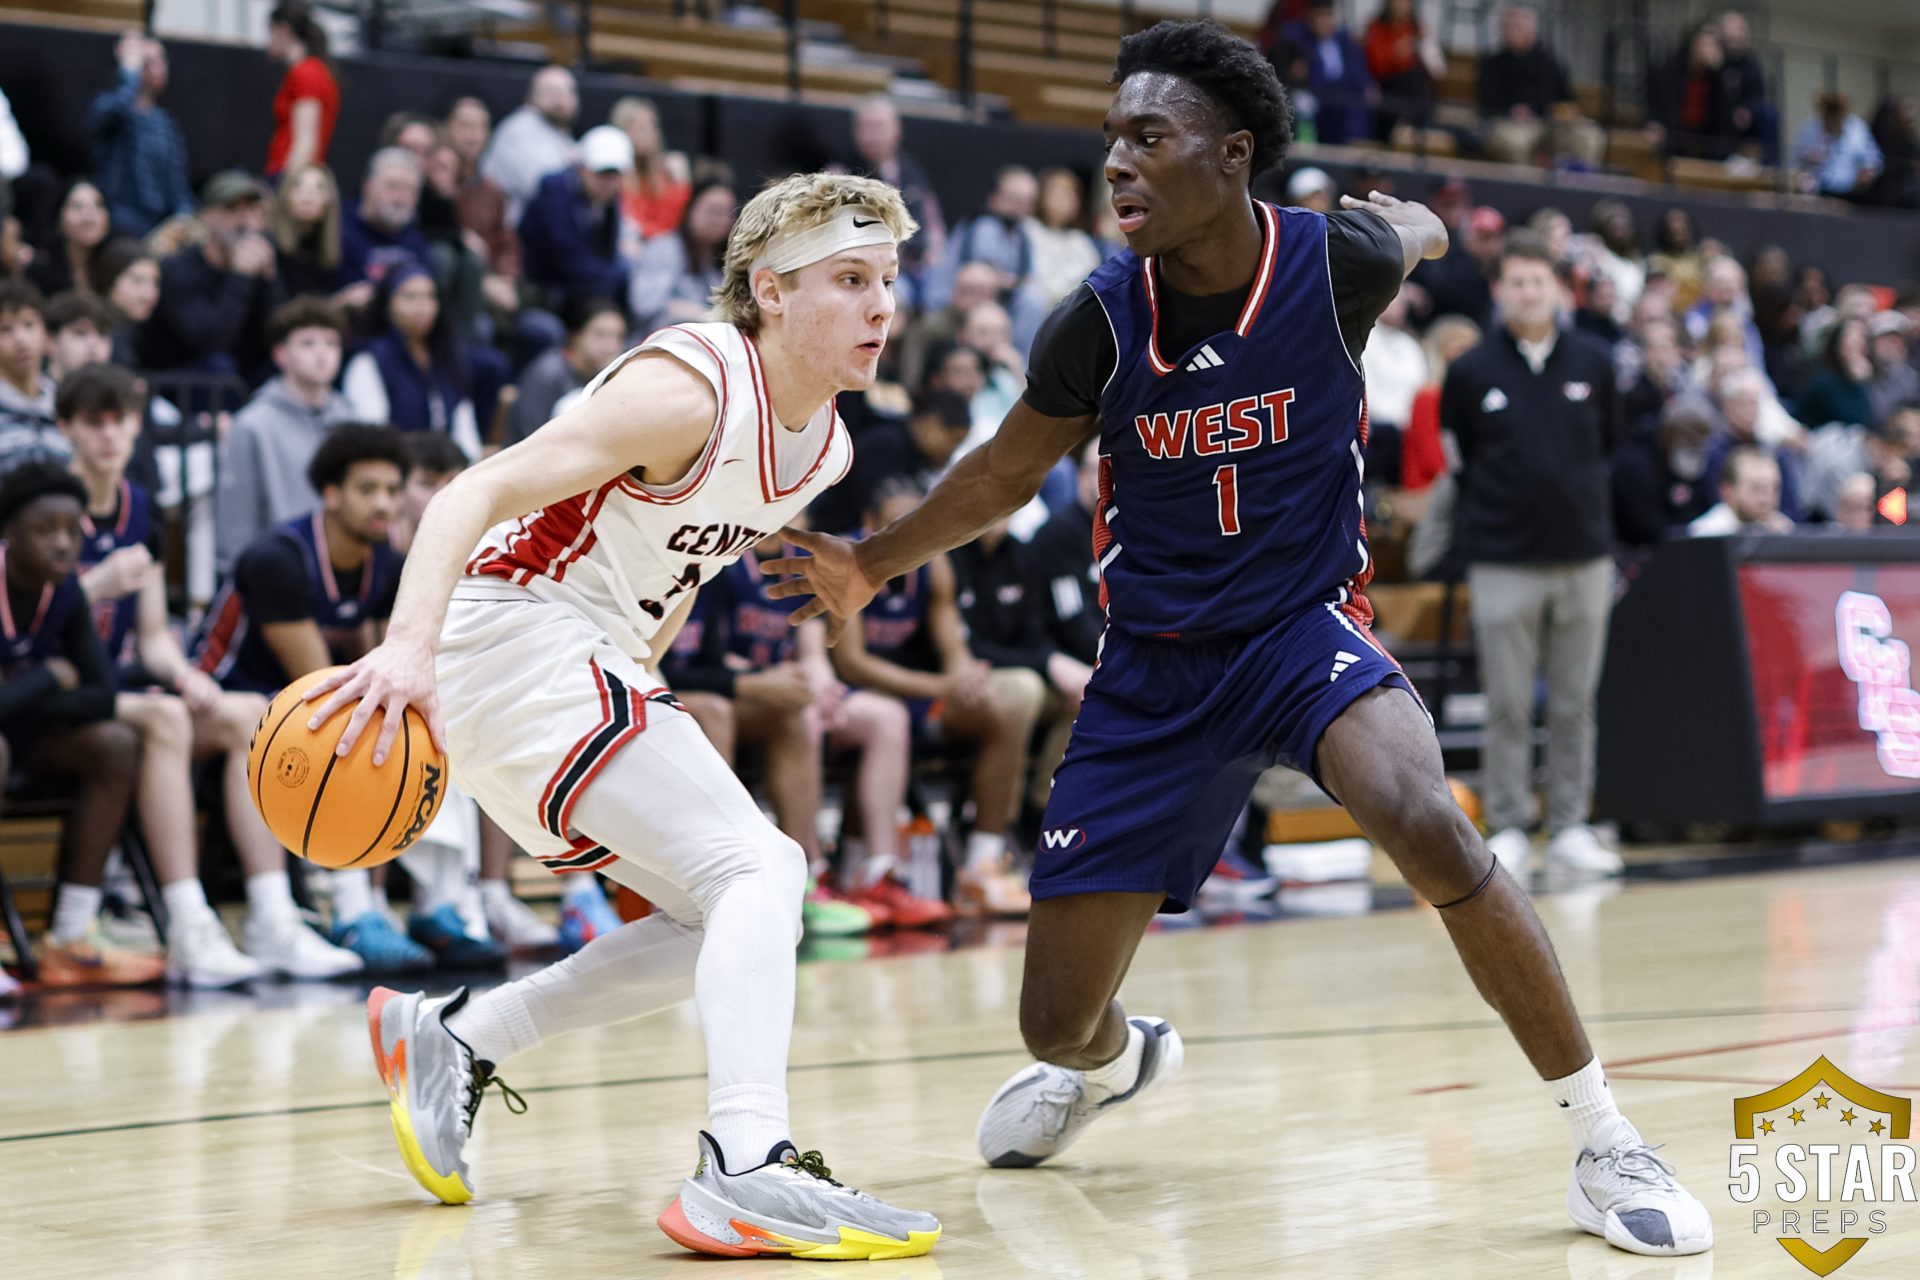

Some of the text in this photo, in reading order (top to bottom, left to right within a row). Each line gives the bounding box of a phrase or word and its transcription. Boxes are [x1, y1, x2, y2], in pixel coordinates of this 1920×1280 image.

[1134, 387, 1295, 459] WEST
[1212, 463, 1241, 536] 1
[391, 763, 440, 850] NCAA
[1043, 829, 1079, 849] W
